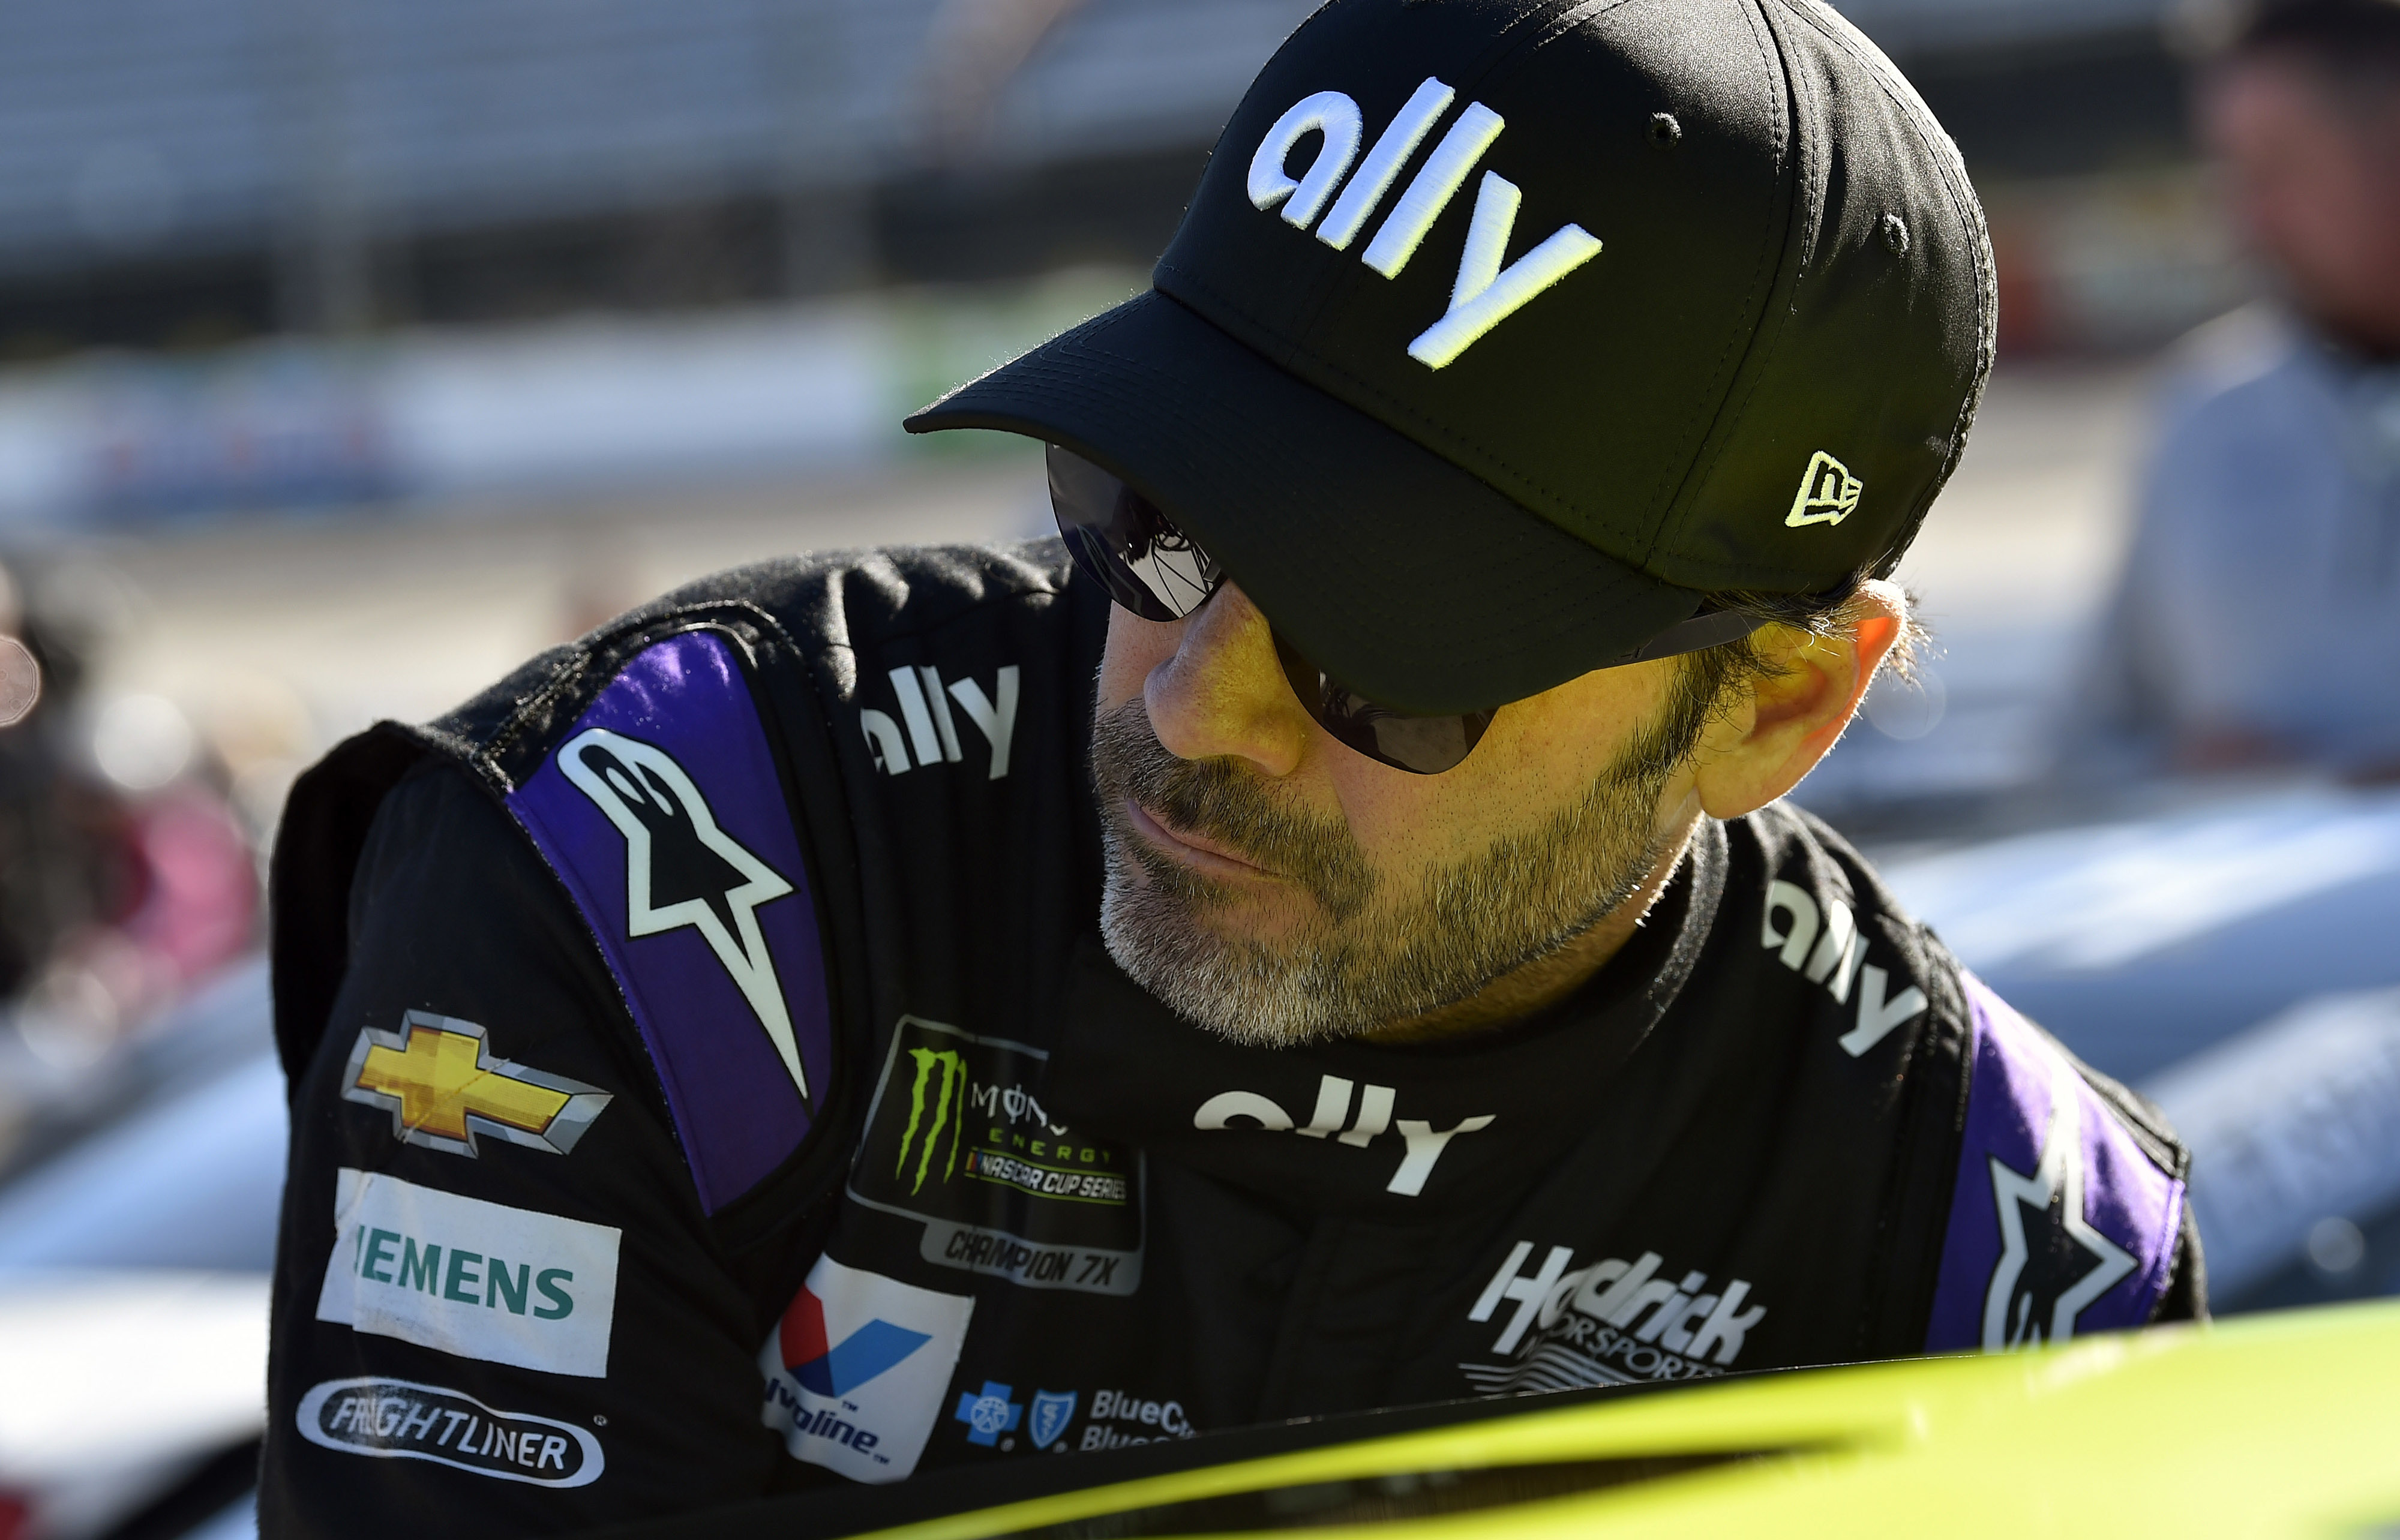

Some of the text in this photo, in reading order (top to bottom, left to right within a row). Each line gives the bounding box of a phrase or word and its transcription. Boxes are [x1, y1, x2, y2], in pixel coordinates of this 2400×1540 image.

[1247, 76, 1603, 371] ally
[860, 664, 1020, 781] ally
[1760, 878, 1929, 1058] ally
[980, 1154, 1128, 1200] NASCAR CUP SERIES
[944, 1230, 1121, 1286] CHAMPION 7X
